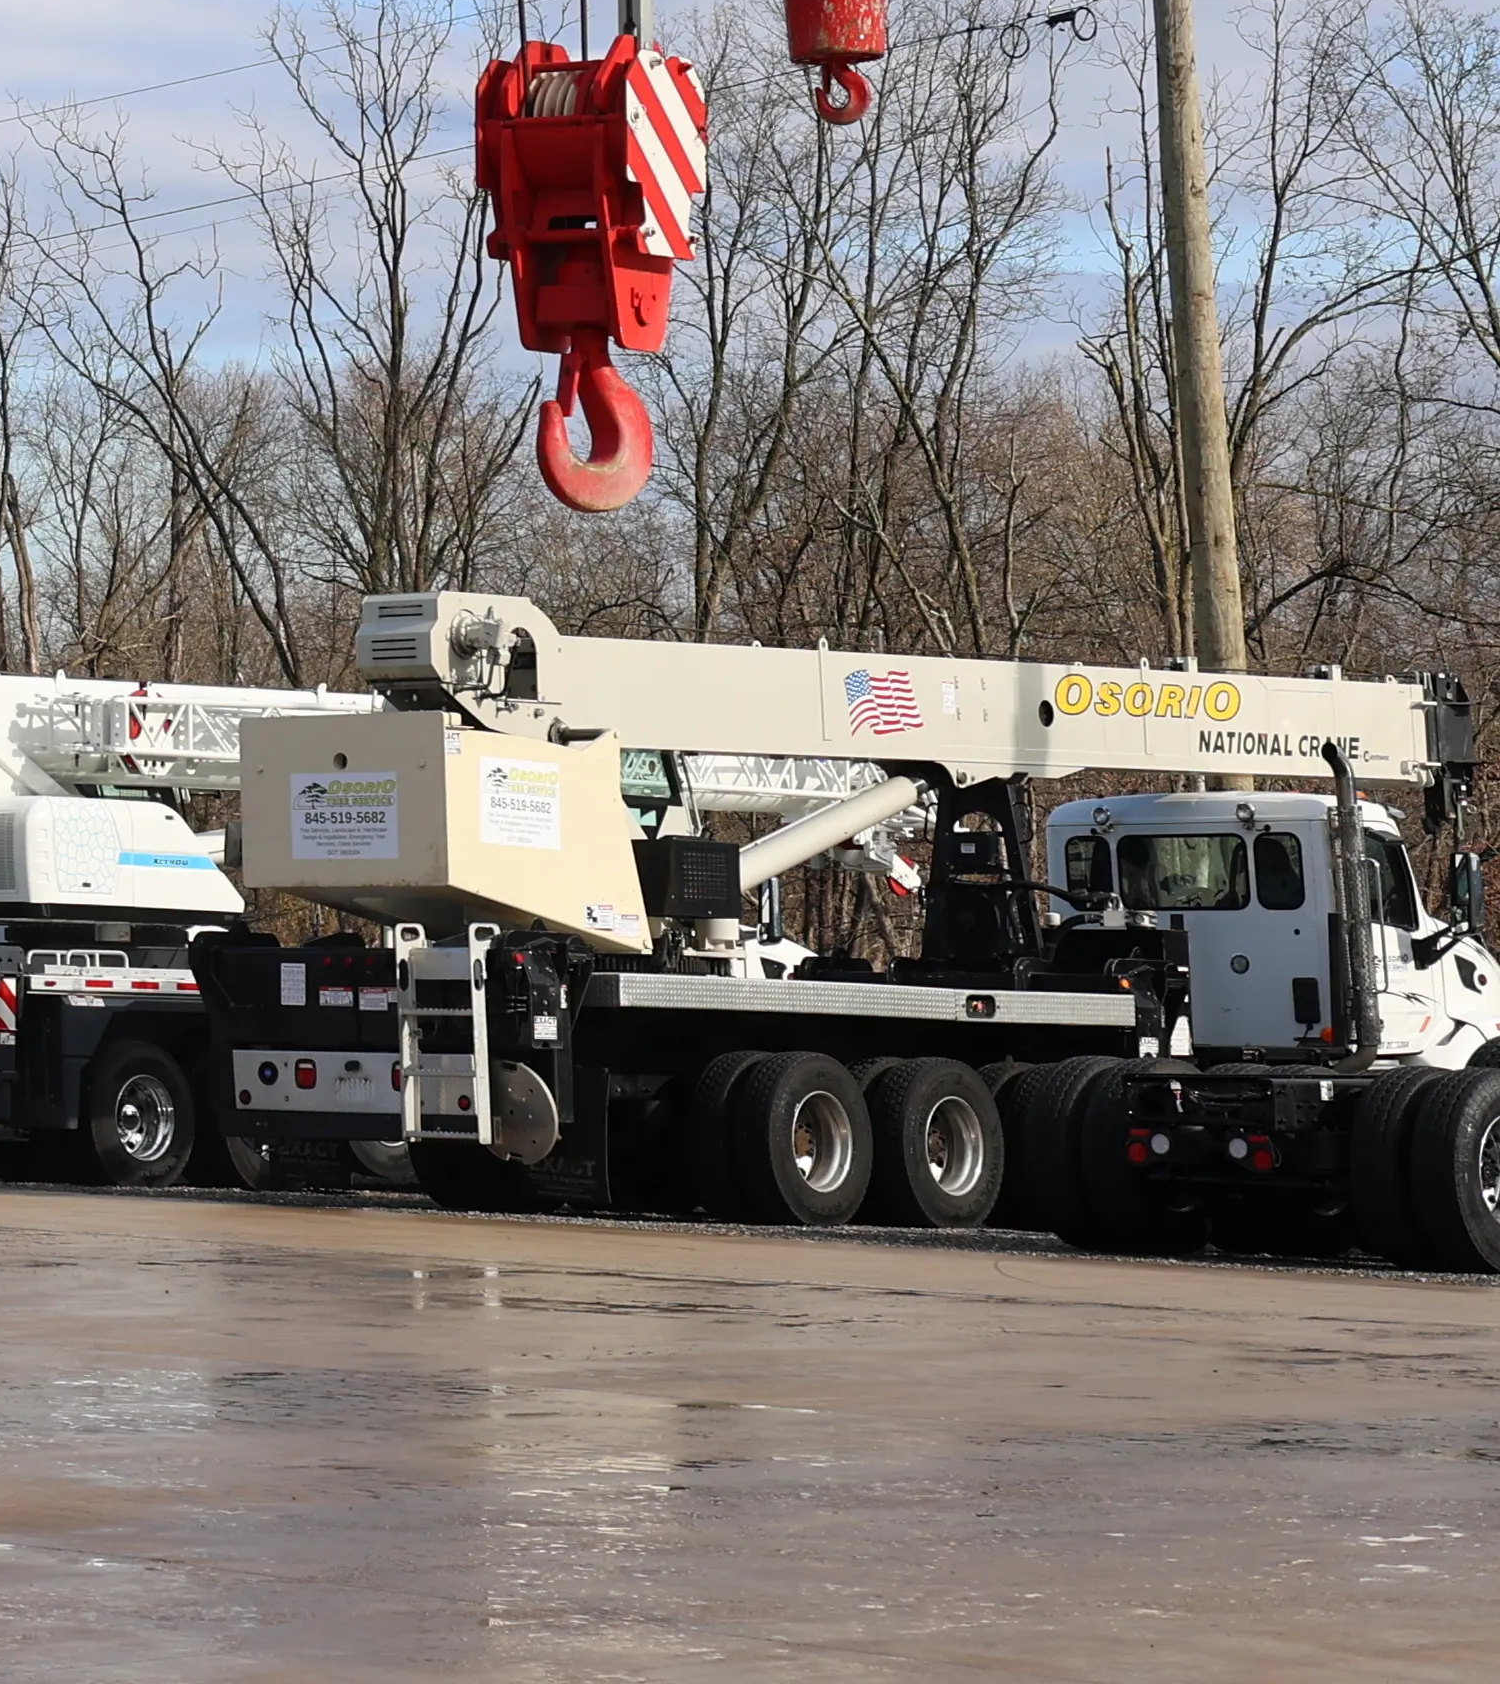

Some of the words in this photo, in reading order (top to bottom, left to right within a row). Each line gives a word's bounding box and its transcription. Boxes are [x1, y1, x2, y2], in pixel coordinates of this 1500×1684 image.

[1199, 730, 1293, 757] NATIONAL
[1298, 735, 1360, 759] CRNE
[490, 796, 552, 814] 845-519-5682
[304, 811, 386, 825] 845-519-5682
